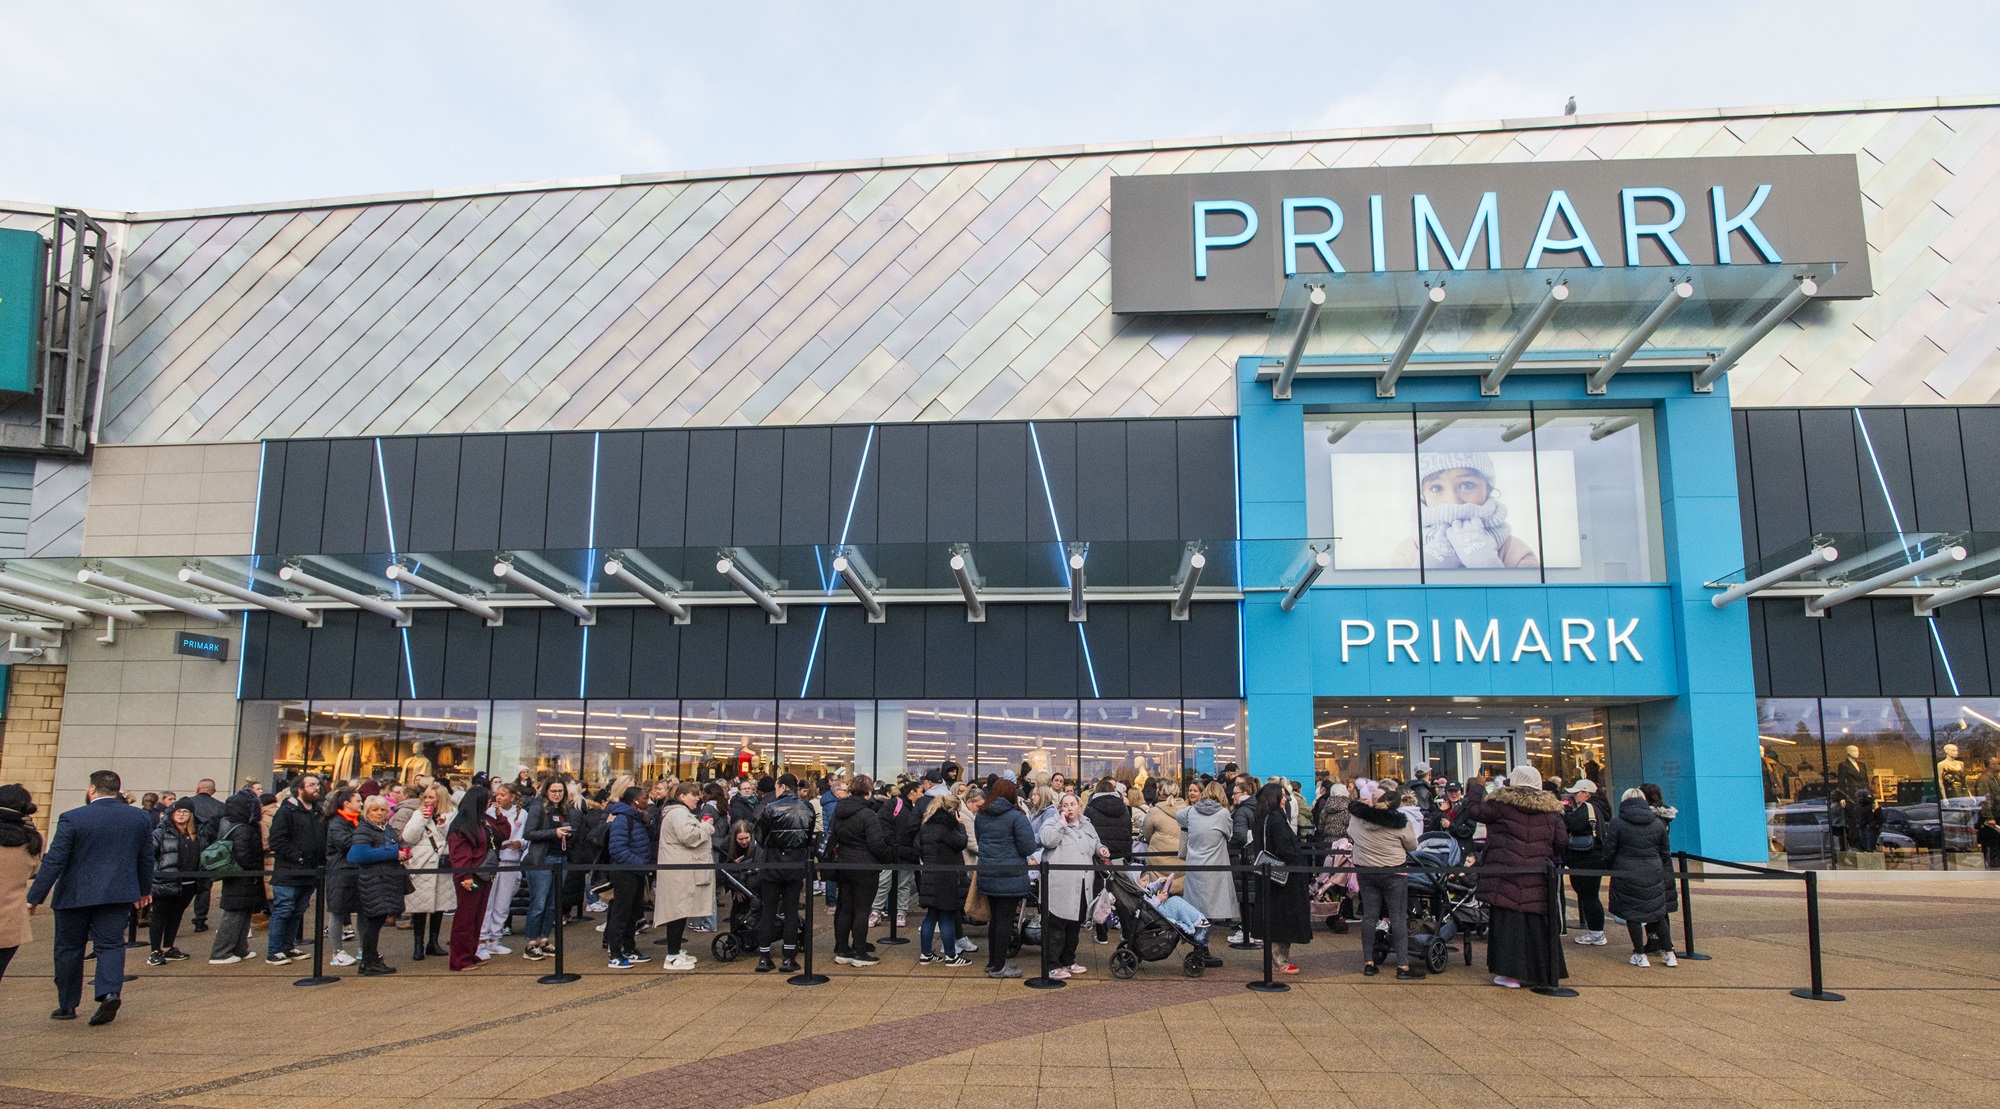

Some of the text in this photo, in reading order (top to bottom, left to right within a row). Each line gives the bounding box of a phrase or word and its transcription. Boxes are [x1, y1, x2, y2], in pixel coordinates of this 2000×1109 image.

[1193, 184, 1784, 279] PRIMARK
[1463, 540, 1488, 556] STITCH
[183, 639, 219, 652] PRIMARK
[1340, 617, 1644, 663] PRIMARK
